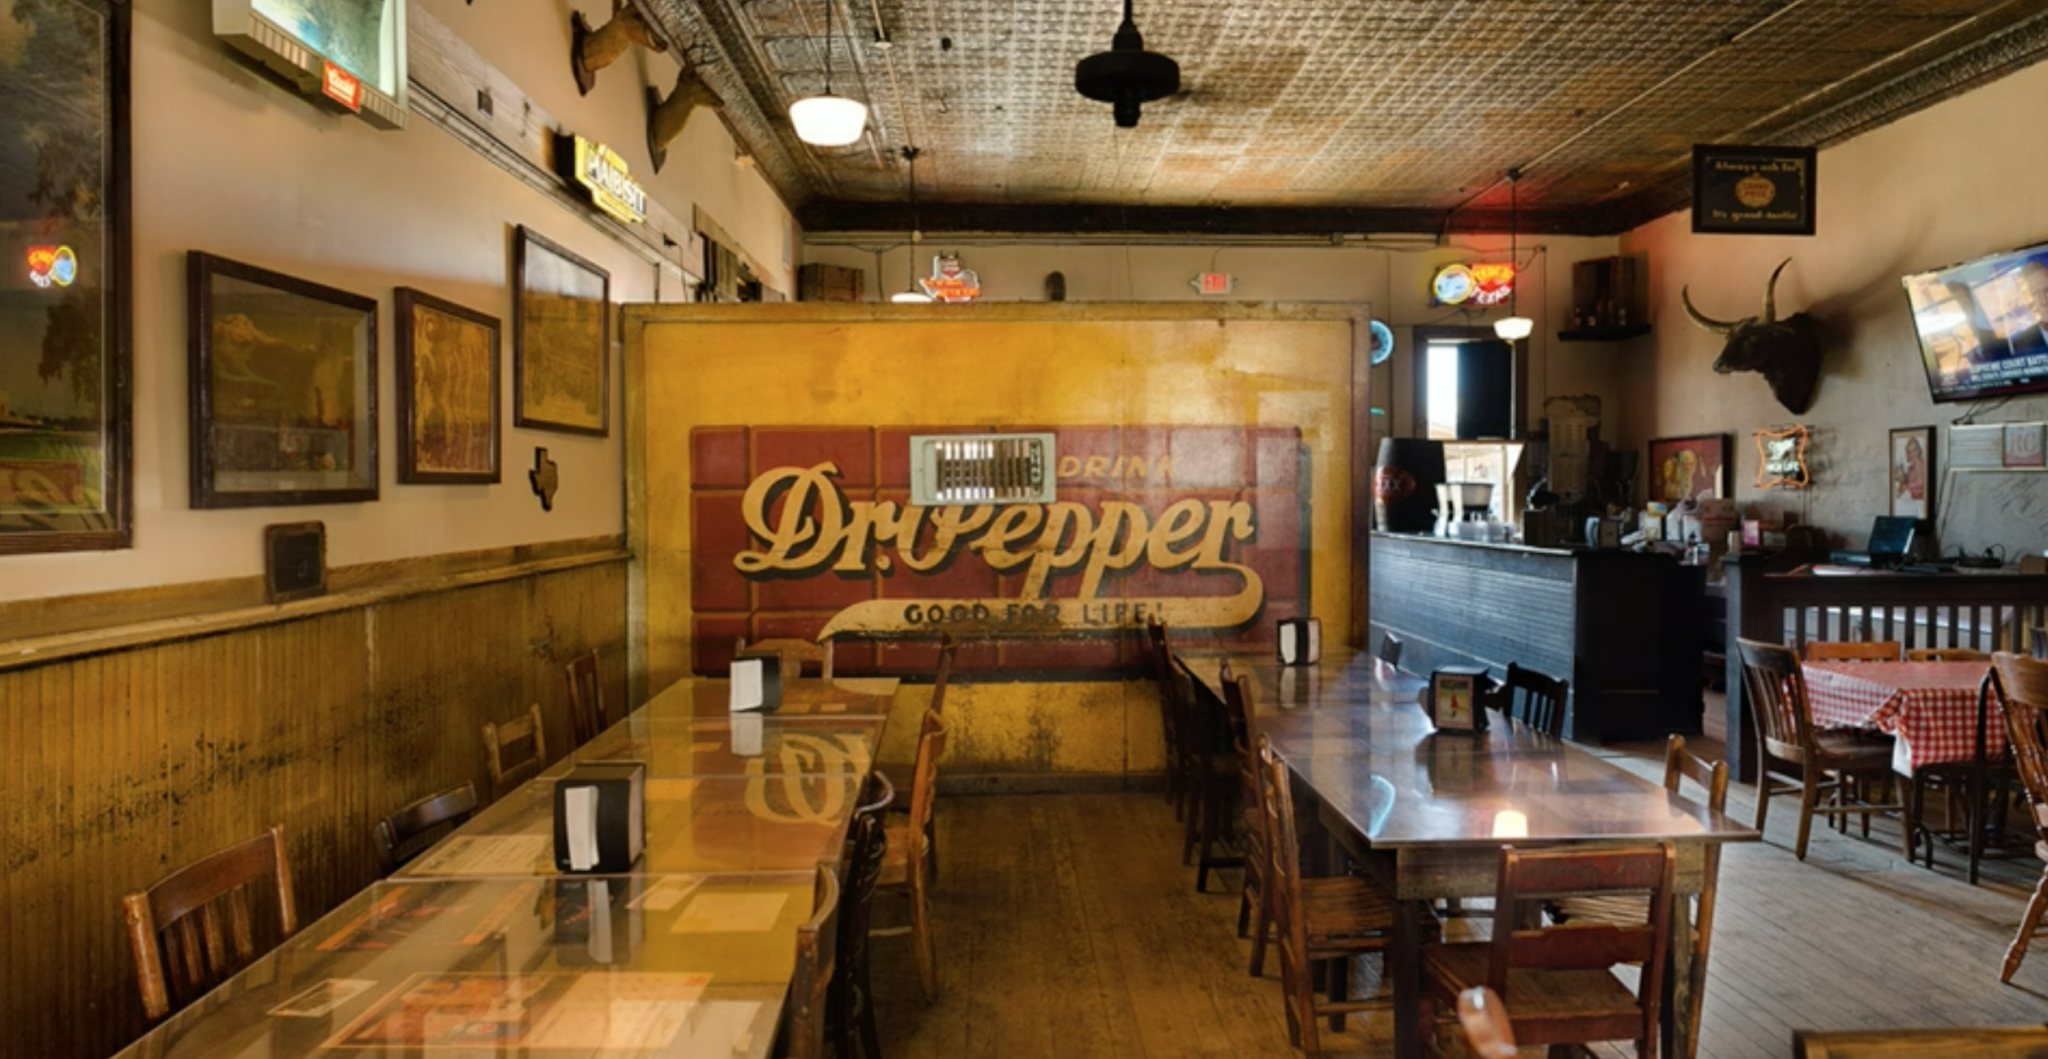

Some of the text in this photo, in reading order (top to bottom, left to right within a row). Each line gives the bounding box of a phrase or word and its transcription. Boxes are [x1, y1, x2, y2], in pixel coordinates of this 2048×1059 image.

[1057, 455, 1174, 479] DRINK
[903, 602, 990, 626] GOOD
[1006, 603, 1061, 626] FOR
